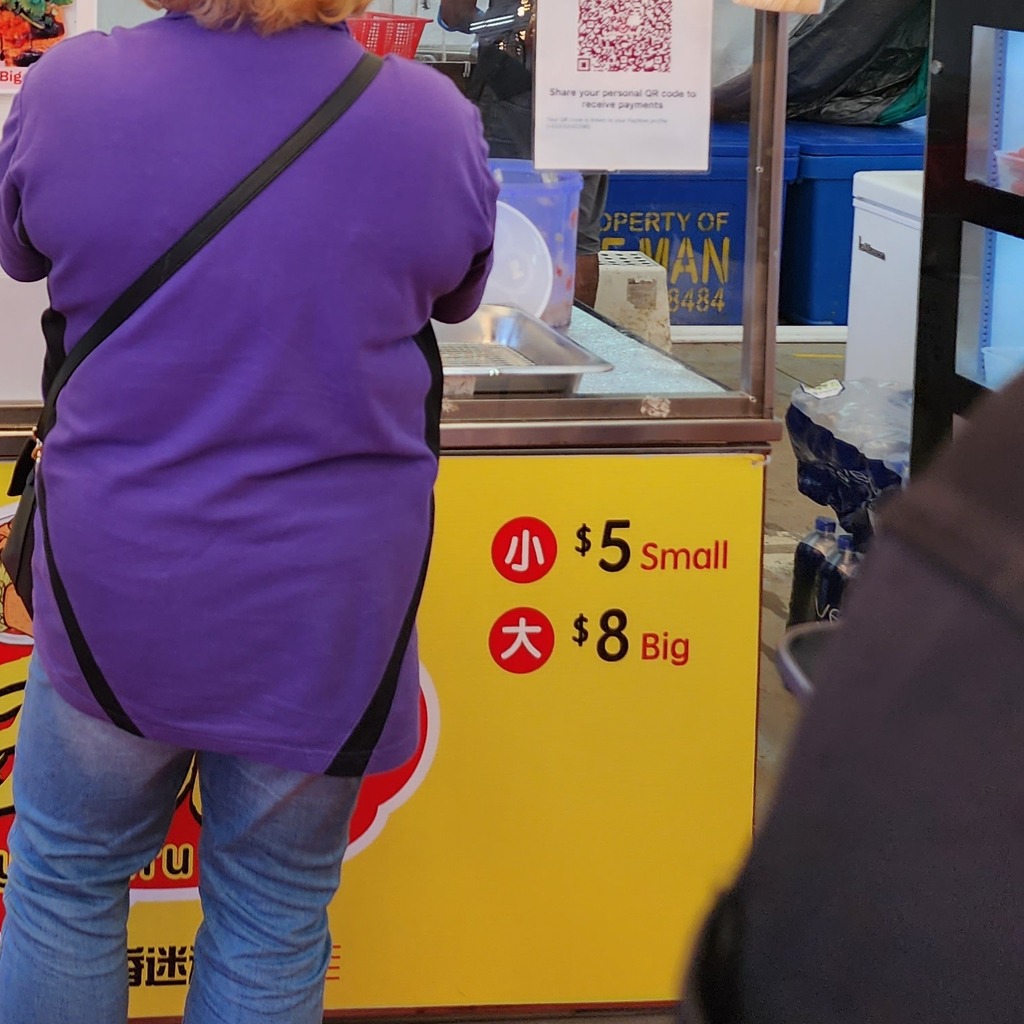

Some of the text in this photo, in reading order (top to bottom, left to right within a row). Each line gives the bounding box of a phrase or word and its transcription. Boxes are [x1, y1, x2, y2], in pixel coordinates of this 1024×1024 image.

[0, 70, 23, 85] Big
[549, 88, 697, 98] Share your personal QR code to
[581, 101, 664, 110] receive payments
[599, 211, 730, 233] OPERTY OF
[505, 519, 728, 572] 小 $5 Small
[500, 608, 690, 666] 大 $8 Big
